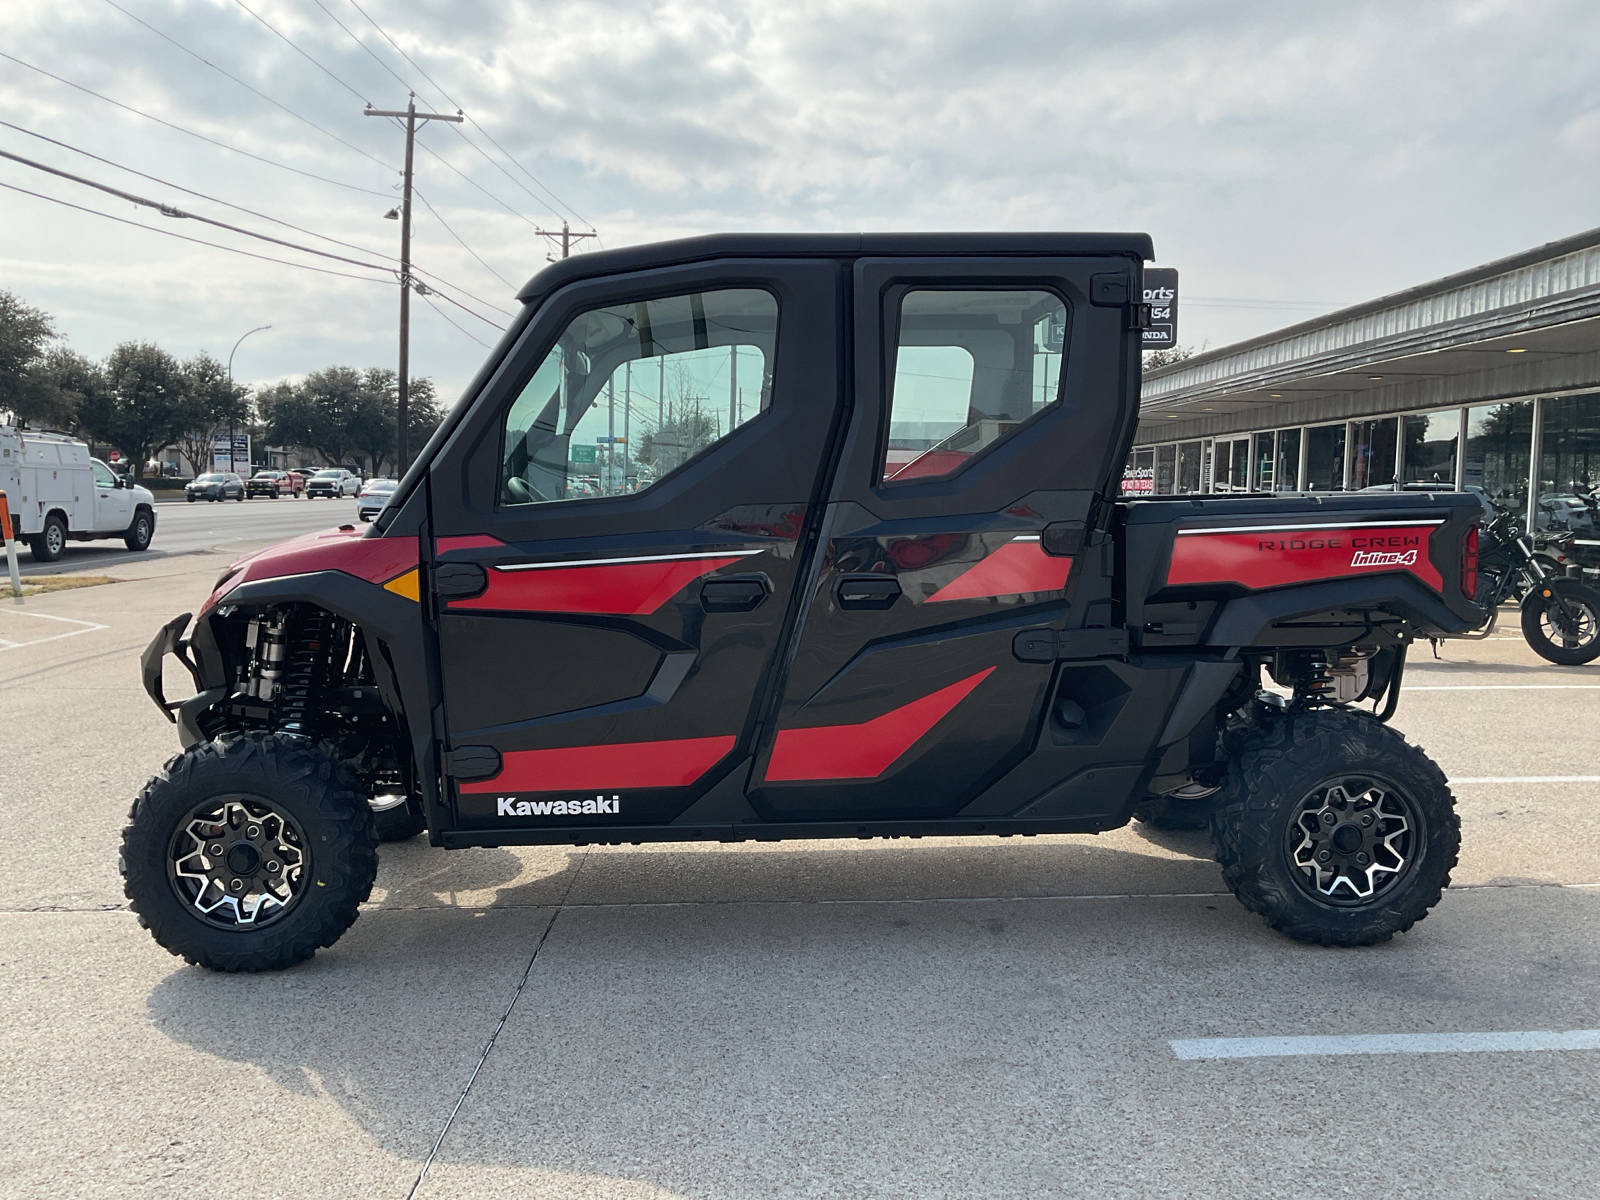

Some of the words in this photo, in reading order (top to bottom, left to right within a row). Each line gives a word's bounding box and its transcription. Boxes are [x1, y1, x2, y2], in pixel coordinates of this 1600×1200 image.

[1258, 538, 1342, 551] RIDGE
[1351, 536, 1419, 548] CREW
[1350, 550, 1418, 567] Inline-4
[496, 795, 620, 816] Kawasaki
